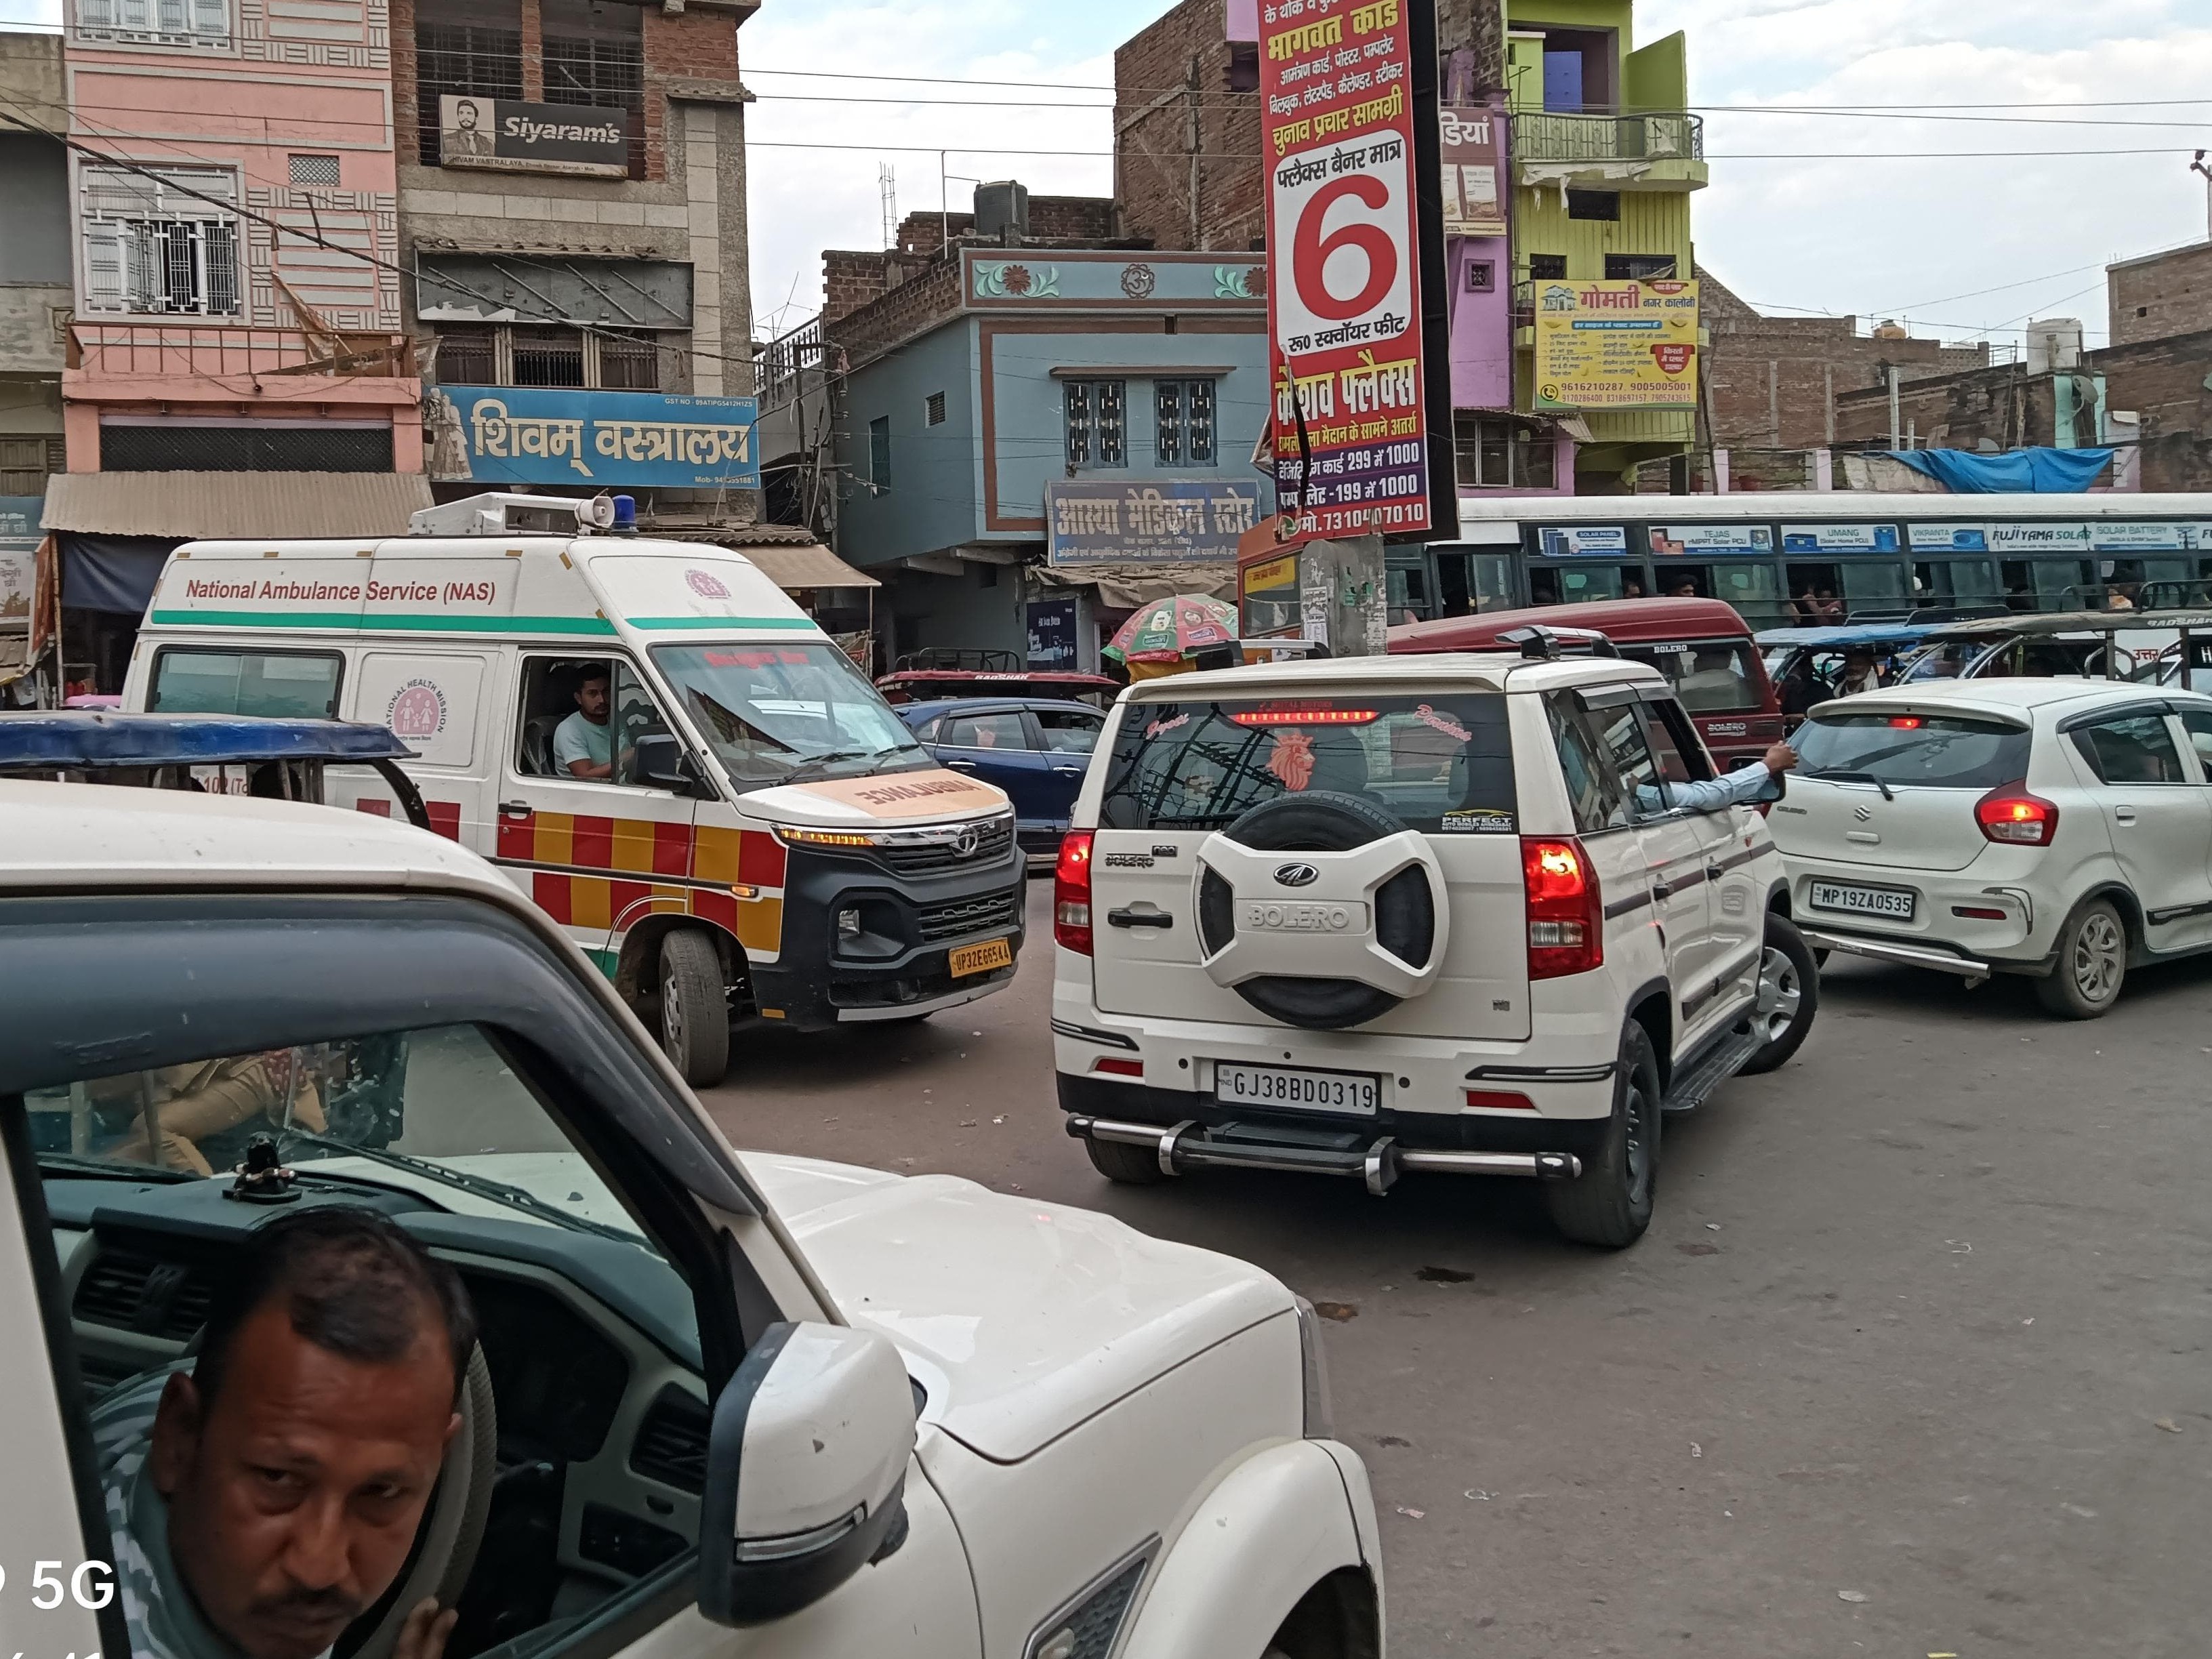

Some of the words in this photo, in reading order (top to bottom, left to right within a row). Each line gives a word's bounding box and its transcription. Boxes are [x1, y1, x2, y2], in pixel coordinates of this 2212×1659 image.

[1268, 14, 1343, 61] भागवत
[1280, 61, 1311, 85] आमंत्रण
[1334, 47, 1361, 68] पोस्टर,
[1376, 60, 1404, 84] स्टीकर
[504, 117, 620, 144] Siyaram's
[1272, 119, 1311, 156] चुनाव
[1313, 107, 1350, 142] प्रचार
[1352, 84, 1404, 127] सामग्री
[1277, 158, 1327, 188] फ्लैक्स
[1331, 147, 1366, 173] बैनर
[1369, 139, 1401, 164] मात्र
[1293, 174, 1397, 320] 6
[1580, 284, 1641, 309] गोमती
[1643, 298, 1661, 308] नगर
[1665, 296, 1696, 308] कालोनी
[1374, 312, 1405, 335] फीट
[1275, 366, 1334, 426] केशव
[470, 398, 594, 477] शिवम्
[594, 419, 750, 465] वस्त्रालय
[1322, 424, 1347, 445] मैदान
[1349, 420, 1359, 441] के
[1361, 416, 1388, 439] सामने
[1391, 411, 1416, 436] अतर्रा
[1322, 453, 1344, 474] कार्ड
[1348, 450, 1371, 471] 299
[1374, 449, 1384, 467] में
[1387, 443, 1419, 466] 1000
[1365, 480, 1376, 498] में
[1379, 474, 1418, 496] 1000
[1125, 488, 1206, 535] मेडिकल
[1210, 487, 1255, 535] स्टोर
[1301, 511, 1322, 533] मो.
[1704, 530, 1730, 538] TEJAS
[1827, 529, 1860, 537] UMANG
[1912, 529, 1950, 537] VIKRANTA
[2096, 527, 2127, 535] SOLAR
[2128, 526, 2167, 535] BATTERY
[186, 579, 256, 600] National
[258, 581, 361, 600] Ambulance
[366, 581, 437, 601] Service
[443, 581, 496, 606] (NAS)
[1654, 644, 1687, 653] BOLERO
[386, 687, 407, 730] ATIONAL
[407, 679, 437, 692] HEALTH
[436, 691, 447, 733] MISSION
[1105, 855, 1155, 869] BOLERO
[1153, 846, 1177, 857] neo
[1822, 888, 1911, 913] MP19ZA0535
[1248, 905, 1350, 932] BOLERO
[956, 943, 1009, 971] UP32EG6544
[1233, 1071, 1374, 1108] GJ38BD0319
